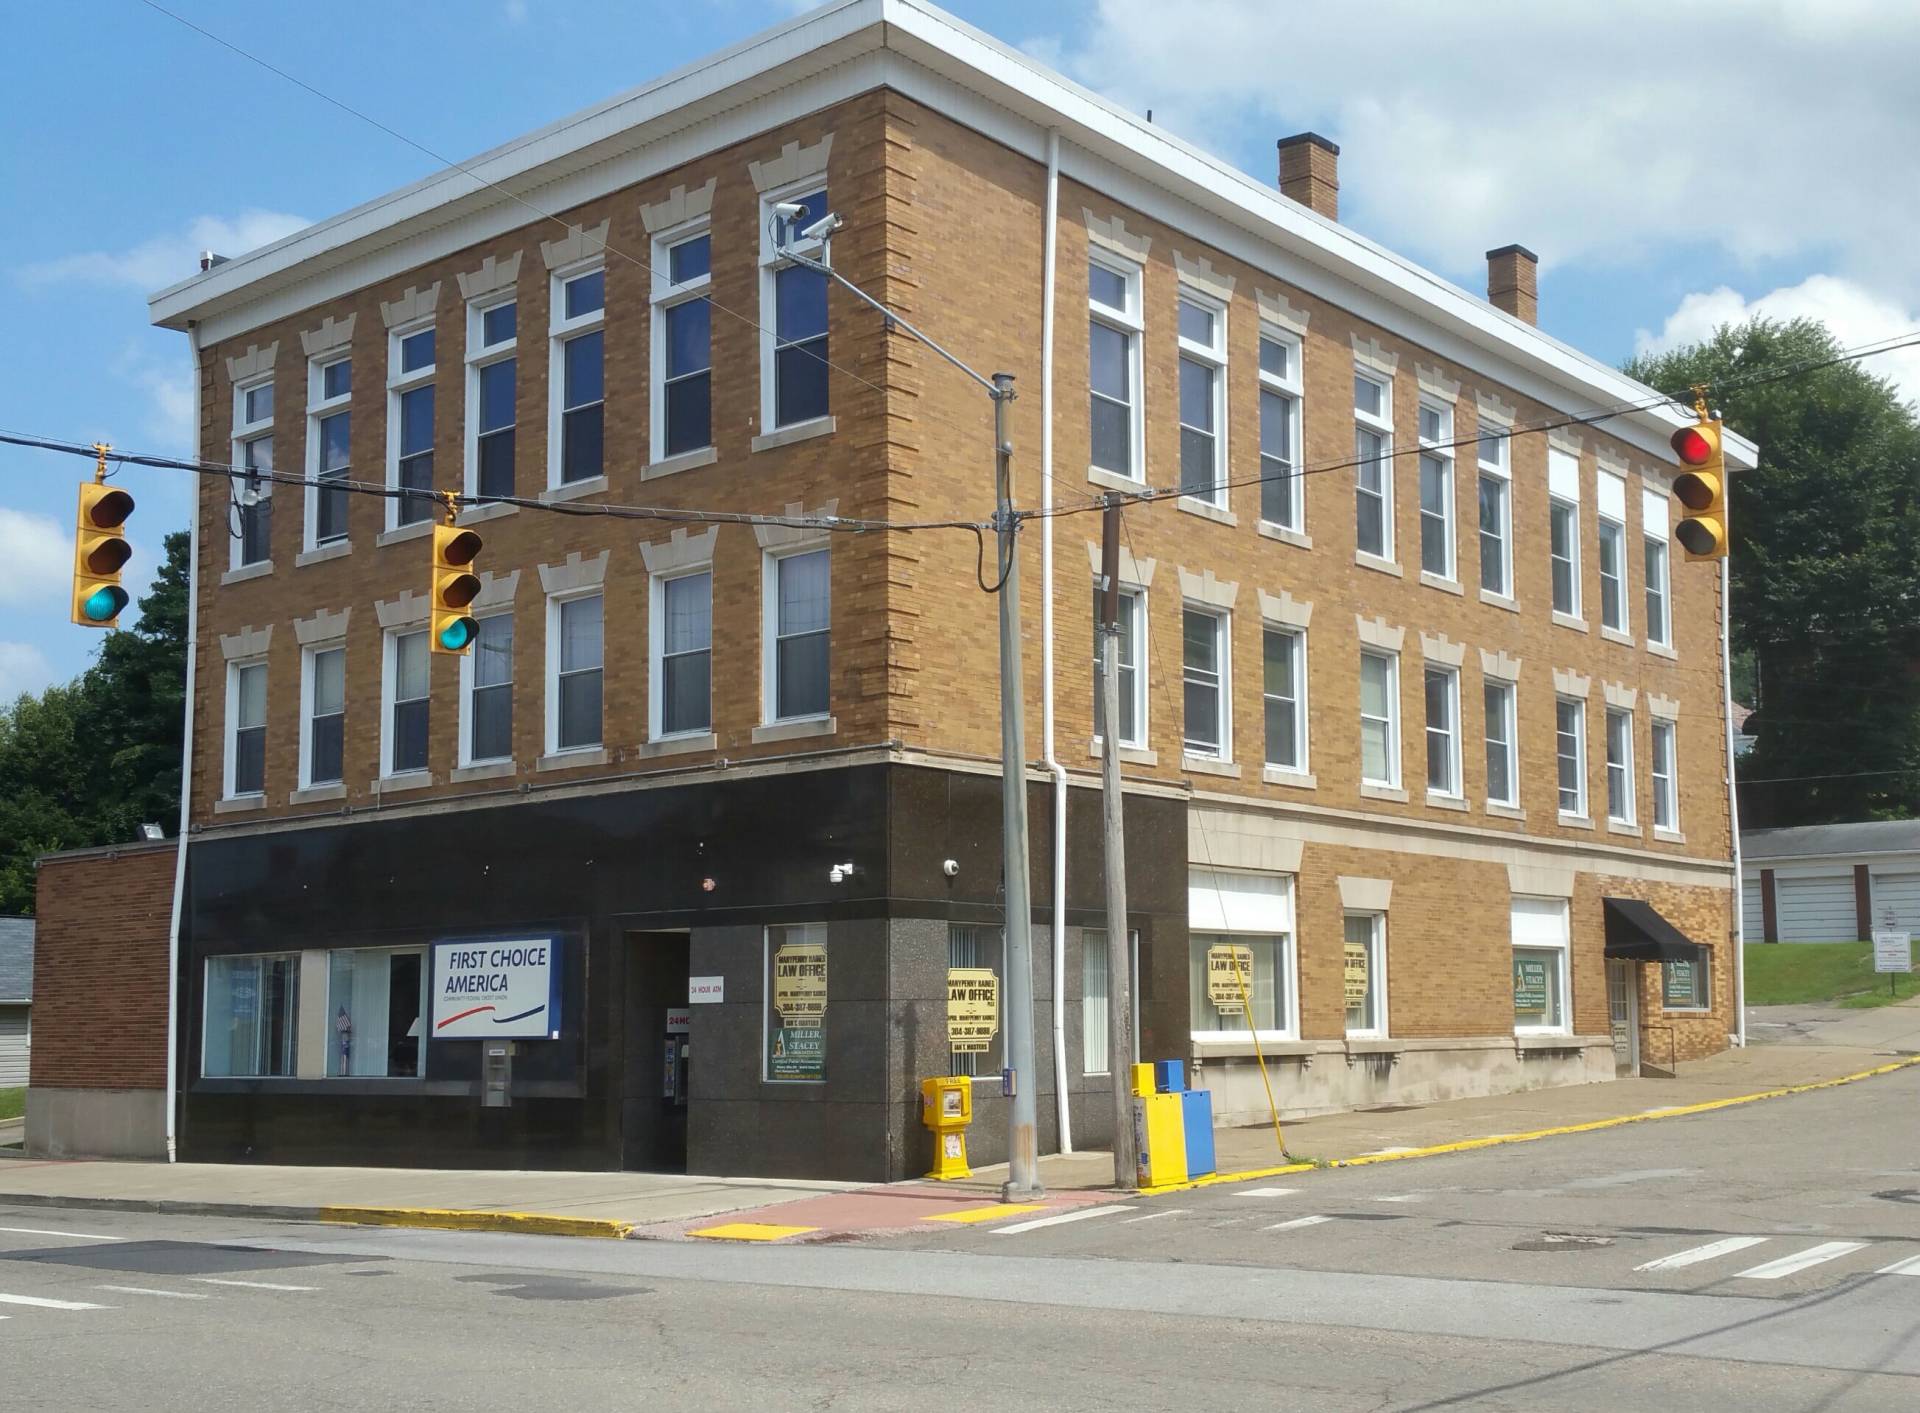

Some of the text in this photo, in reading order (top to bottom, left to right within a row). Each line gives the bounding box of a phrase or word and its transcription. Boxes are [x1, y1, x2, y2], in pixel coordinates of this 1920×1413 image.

[449, 948, 546, 969] FIRST CHOICE
[778, 964, 826, 977] LAW OFFICE
[1211, 961, 1250, 971] LAW OFICE
[445, 974, 508, 993] AMERICA
[712, 985, 721, 993] ATM
[968, 988, 995, 1001] OFFICE
[789, 1041, 820, 1050] STACEY
